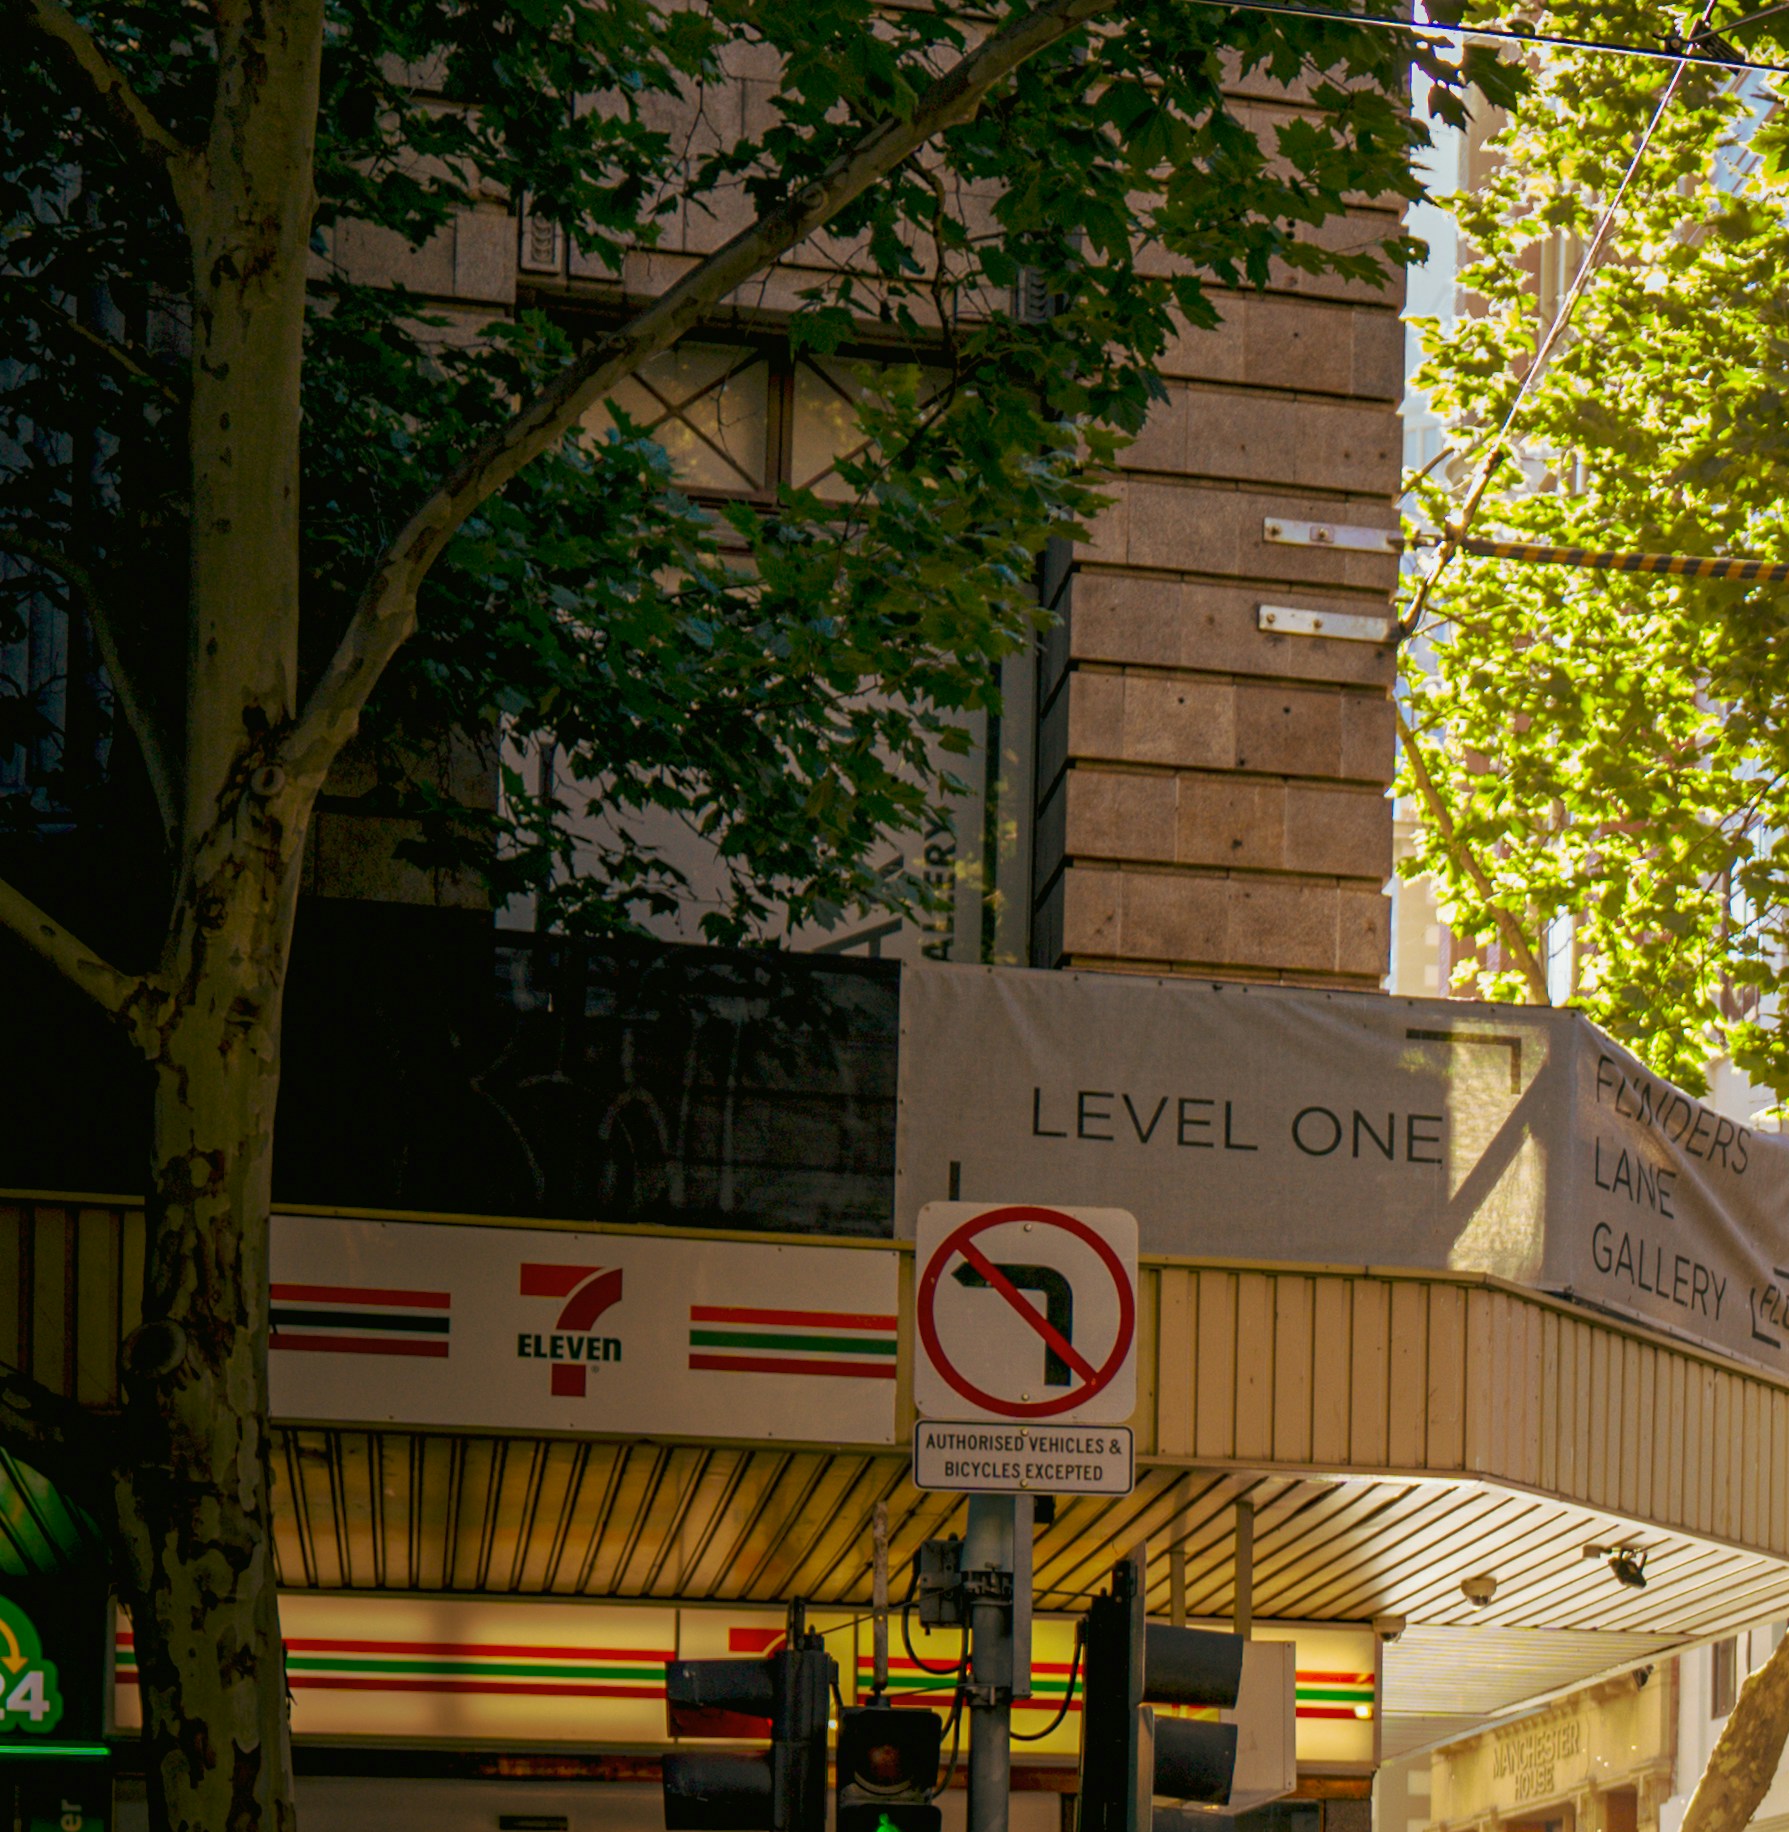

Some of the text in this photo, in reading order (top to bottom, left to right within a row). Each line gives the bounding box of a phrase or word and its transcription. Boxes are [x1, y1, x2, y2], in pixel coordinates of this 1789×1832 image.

[1032, 1086, 1444, 1165] LEVEL ONE
[1594, 1136, 1677, 1220] LANE
[1592, 1221, 1728, 1322] GALLERY
[519, 1262, 623, 1398] 7
[926, 1433, 1122, 1455] AUTHORISED VEHICLES &
[944, 1460, 1103, 1481] BICYCLES EXCEPTED
[0, 1669, 51, 1722] 4
[1493, 1720, 1581, 1780] MANCHESTER
[1515, 1763, 1556, 1801] HOUSE
